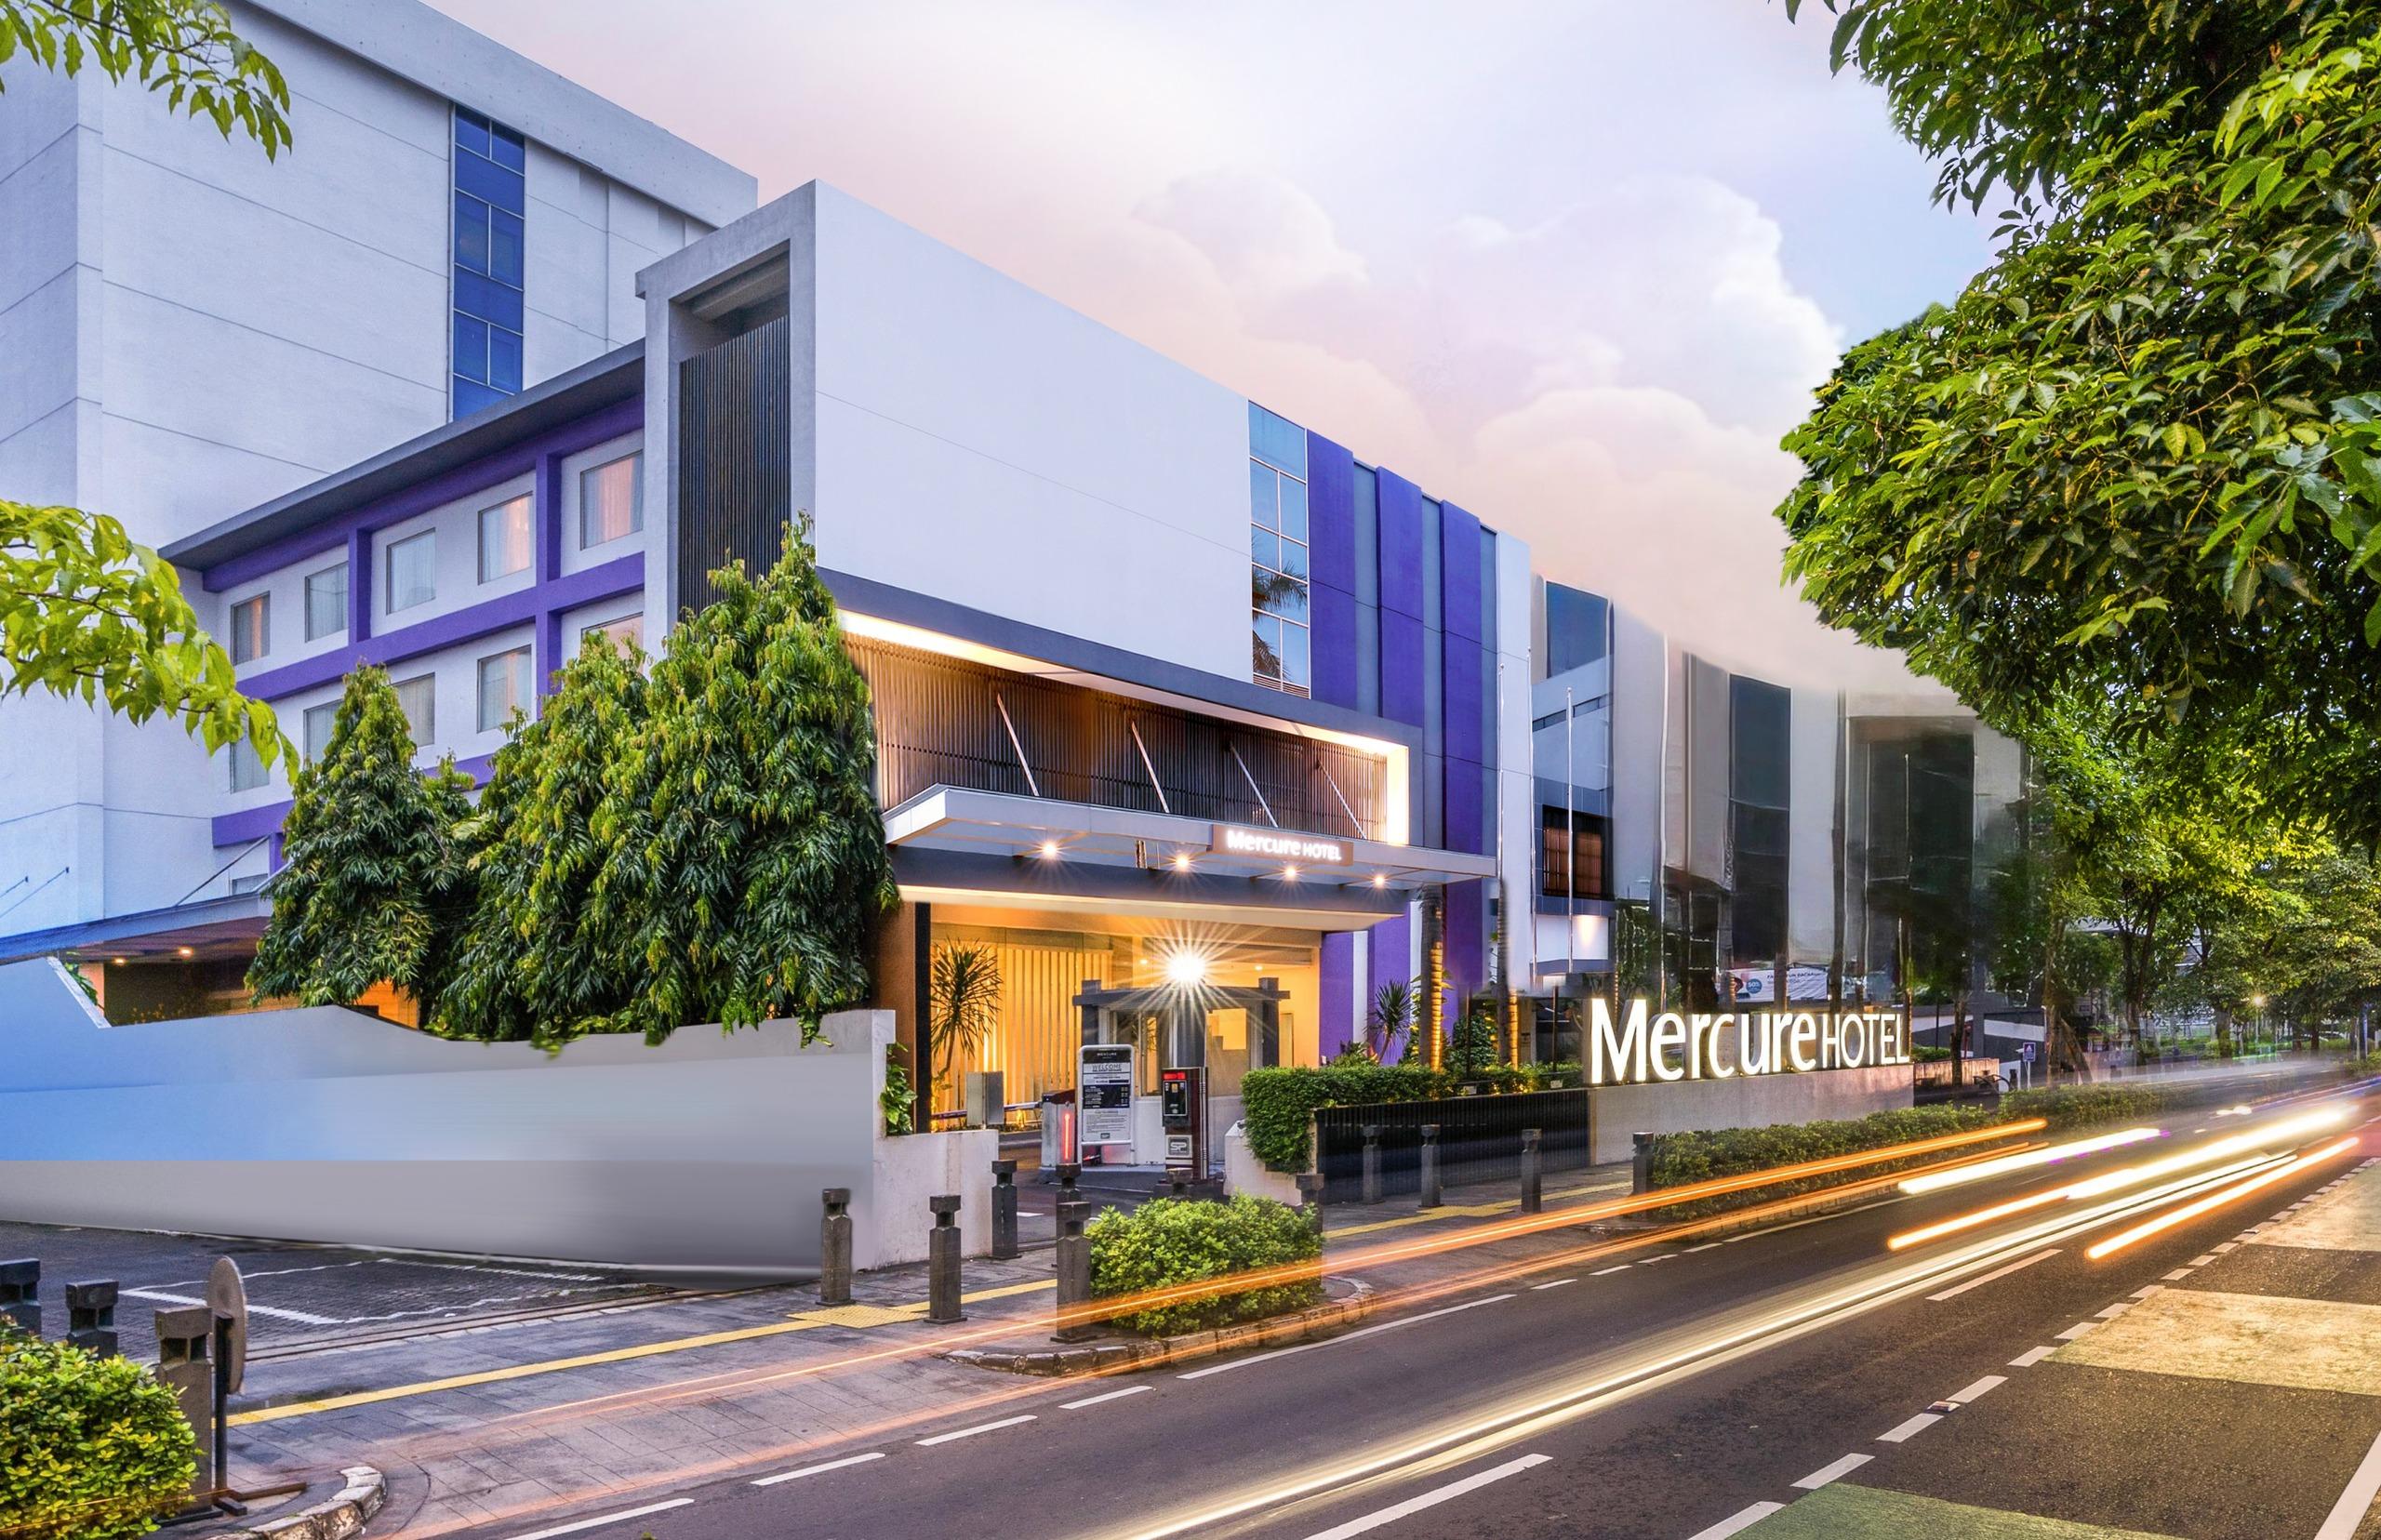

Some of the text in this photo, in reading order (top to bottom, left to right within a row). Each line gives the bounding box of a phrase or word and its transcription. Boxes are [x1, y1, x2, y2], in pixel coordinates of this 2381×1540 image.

[1226, 830, 1342, 861] Mercure HOTEL
[1591, 998, 1909, 1084] Mercure HOTEL
[1170, 1142, 1187, 1152] SP
